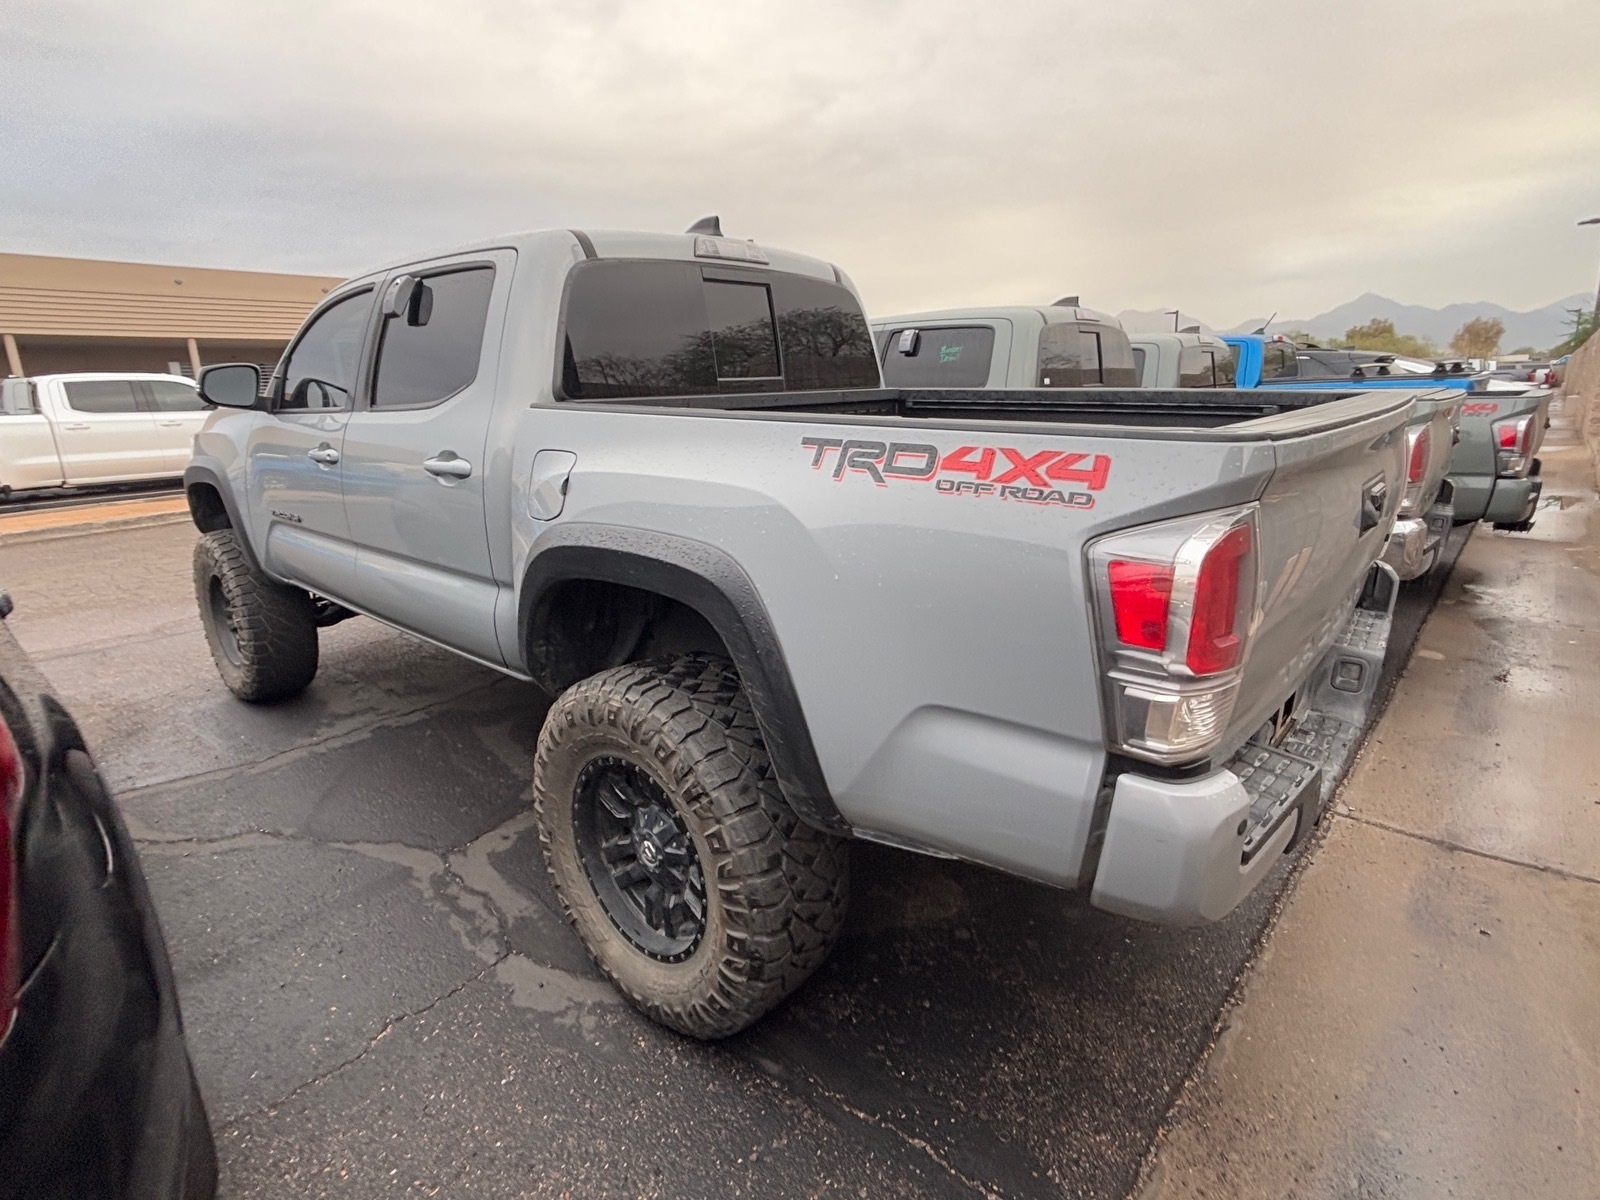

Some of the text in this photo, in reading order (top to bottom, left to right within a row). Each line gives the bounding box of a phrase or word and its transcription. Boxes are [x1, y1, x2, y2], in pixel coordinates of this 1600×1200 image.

[1462, 402, 1498, 413] X4
[801, 437, 1111, 490] TRD 4X4
[935, 479, 1095, 509] OFF ROAD
